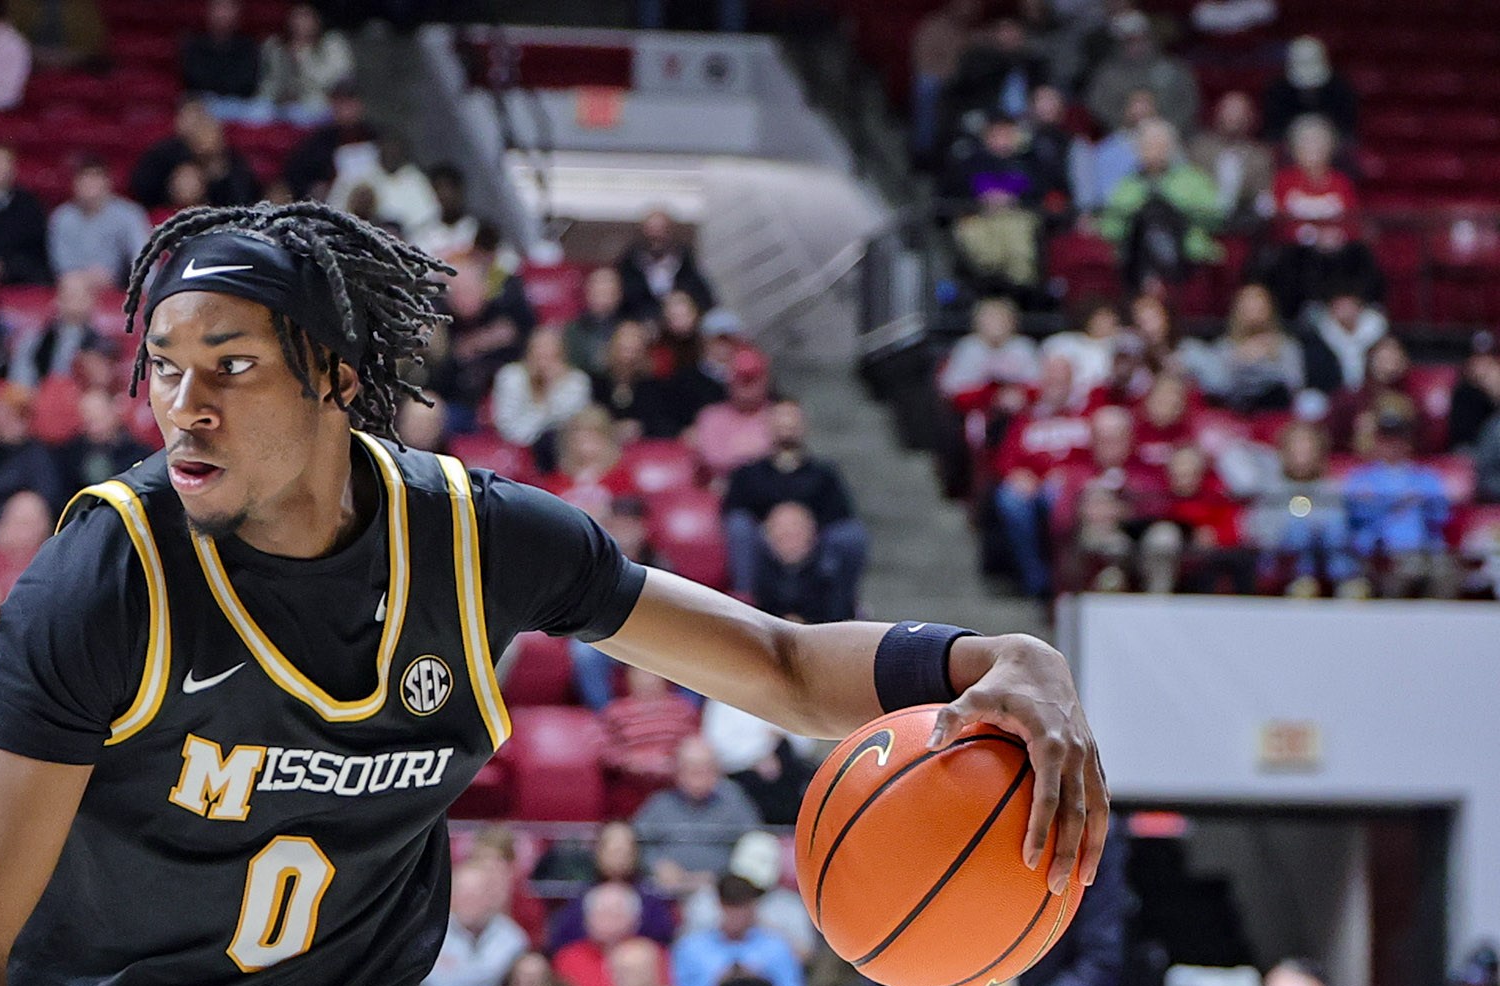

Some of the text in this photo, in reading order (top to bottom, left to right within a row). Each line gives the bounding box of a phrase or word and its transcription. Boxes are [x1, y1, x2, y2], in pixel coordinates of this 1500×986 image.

[405, 660, 448, 711] SEC
[168, 733, 454, 821] MISSOURI
[226, 835, 337, 973] 0
